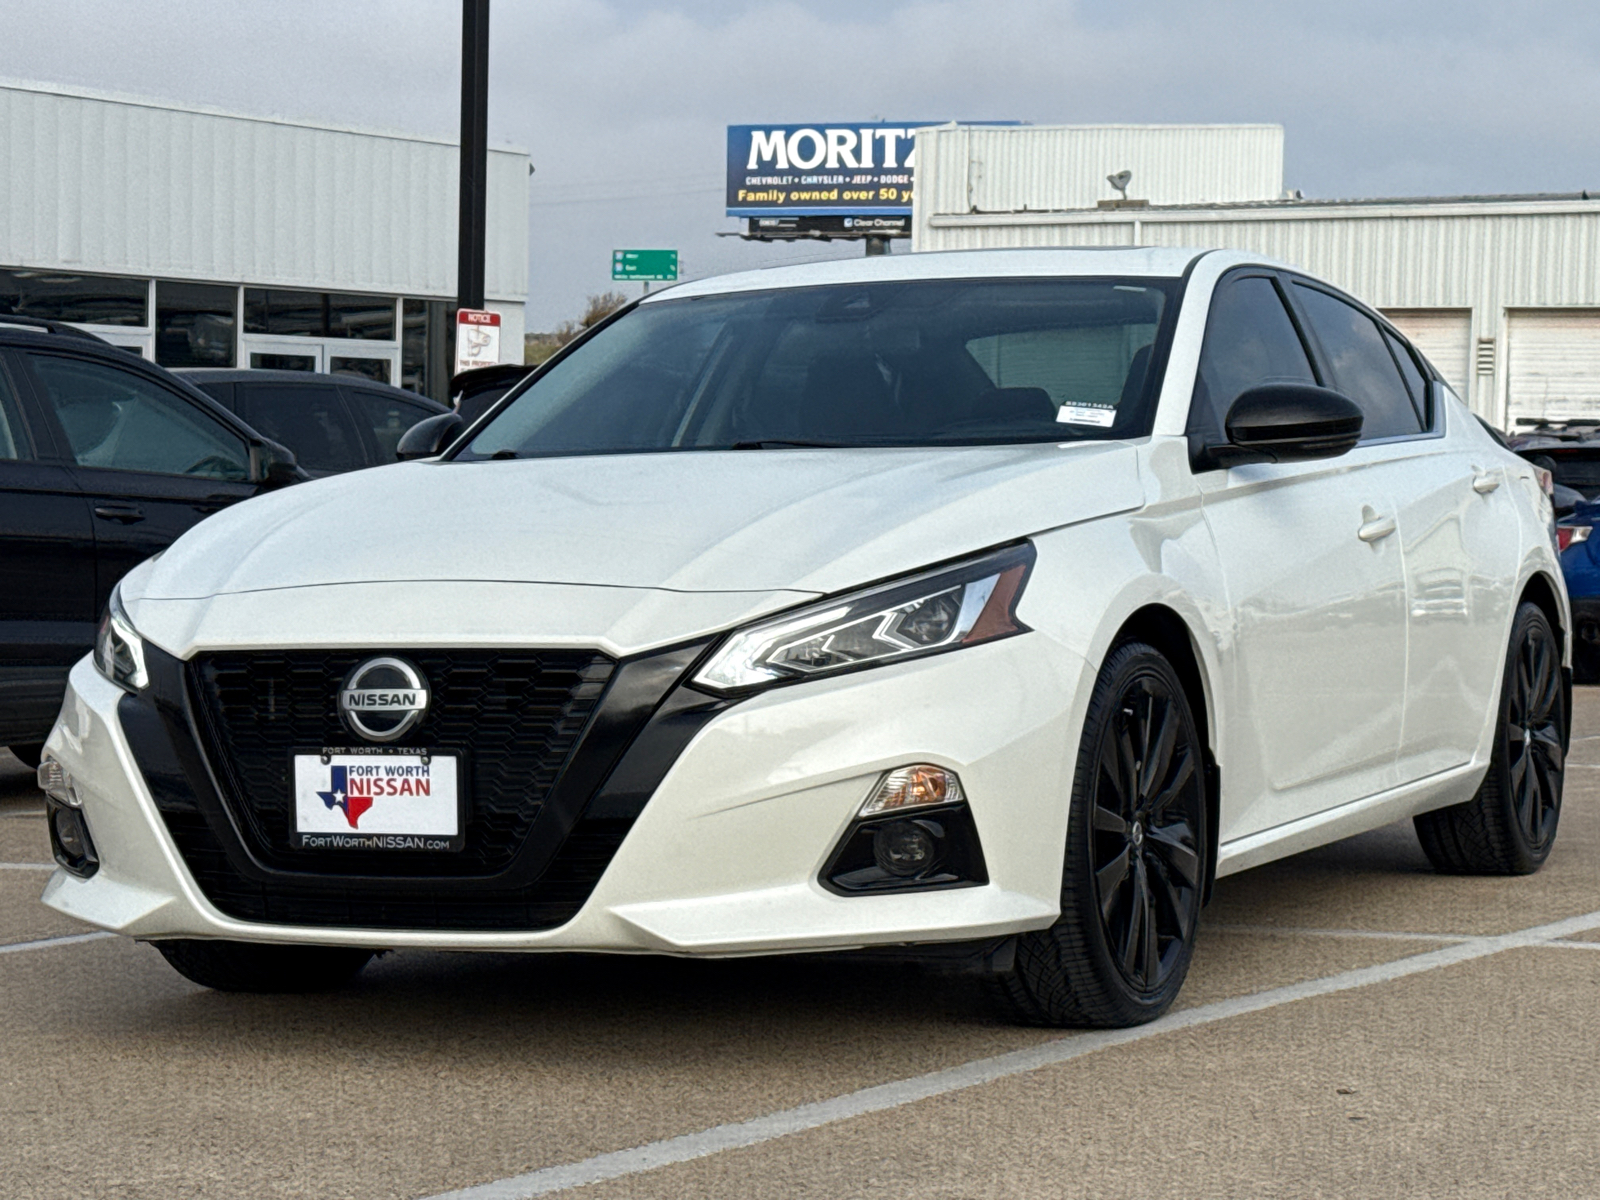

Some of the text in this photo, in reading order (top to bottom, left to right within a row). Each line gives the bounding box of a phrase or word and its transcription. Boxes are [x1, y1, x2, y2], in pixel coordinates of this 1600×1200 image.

[746, 175, 908, 185] CHEVROLET CHRYSLER JEEP DODGE
[738, 189, 786, 204] Family
[790, 188, 838, 200] owned
[843, 190, 875, 200] over
[879, 188, 897, 200] 50
[468, 313, 491, 323] NOTICE
[349, 693, 416, 706] NISSAN
[399, 747, 428, 755] TEXAS
[349, 766, 430, 777] FORT WORTH
[350, 778, 430, 796] NISSAN
